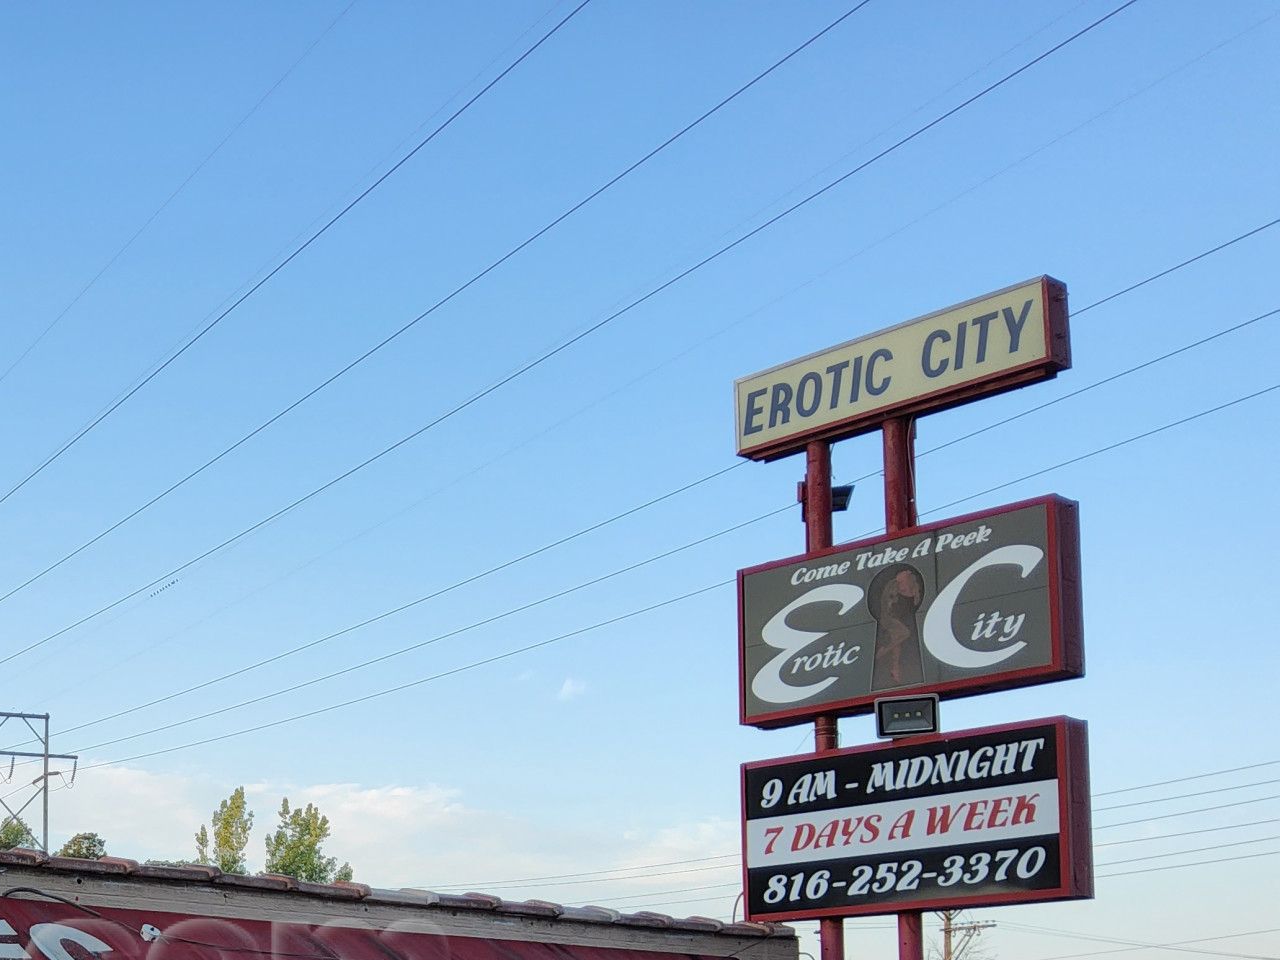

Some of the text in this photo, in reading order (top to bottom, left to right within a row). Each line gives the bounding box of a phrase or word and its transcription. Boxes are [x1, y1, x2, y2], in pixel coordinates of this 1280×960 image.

[743, 299, 1034, 436] EROTIC CITY
[790, 524, 993, 586] Come Take A Peek
[751, 544, 1044, 704] Erotic City
[760, 778, 783, 809] 9
[787, 769, 837, 806] AM
[866, 737, 1045, 795] MIDNIGHT
[763, 793, 1041, 855] 7 DAYS A WEEK
[762, 845, 1047, 905] 816-252-3370
